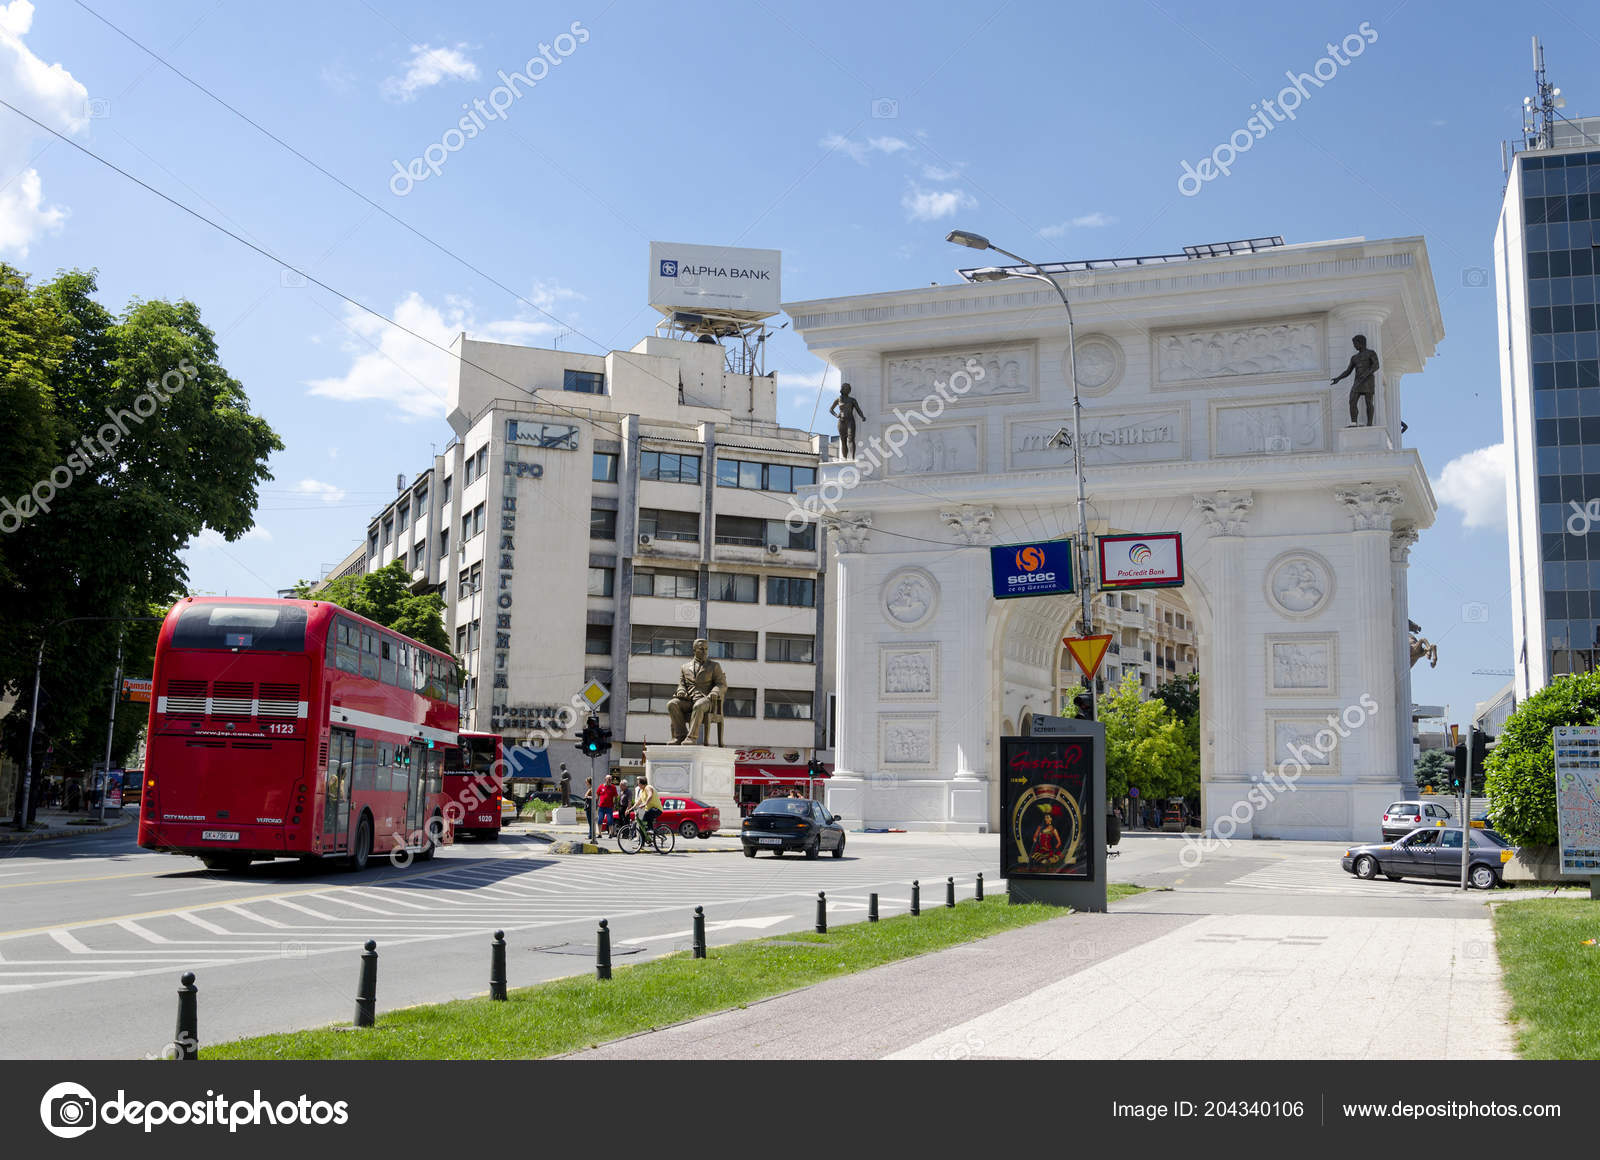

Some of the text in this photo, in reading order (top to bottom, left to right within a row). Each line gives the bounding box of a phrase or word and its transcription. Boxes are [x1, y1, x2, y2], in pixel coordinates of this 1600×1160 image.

[682, 265, 770, 280] ALPHA BANK
[1007, 572, 1056, 584] setec
[1117, 568, 1166, 577] ProCredit Bank
[270, 724, 294, 734] 1123
